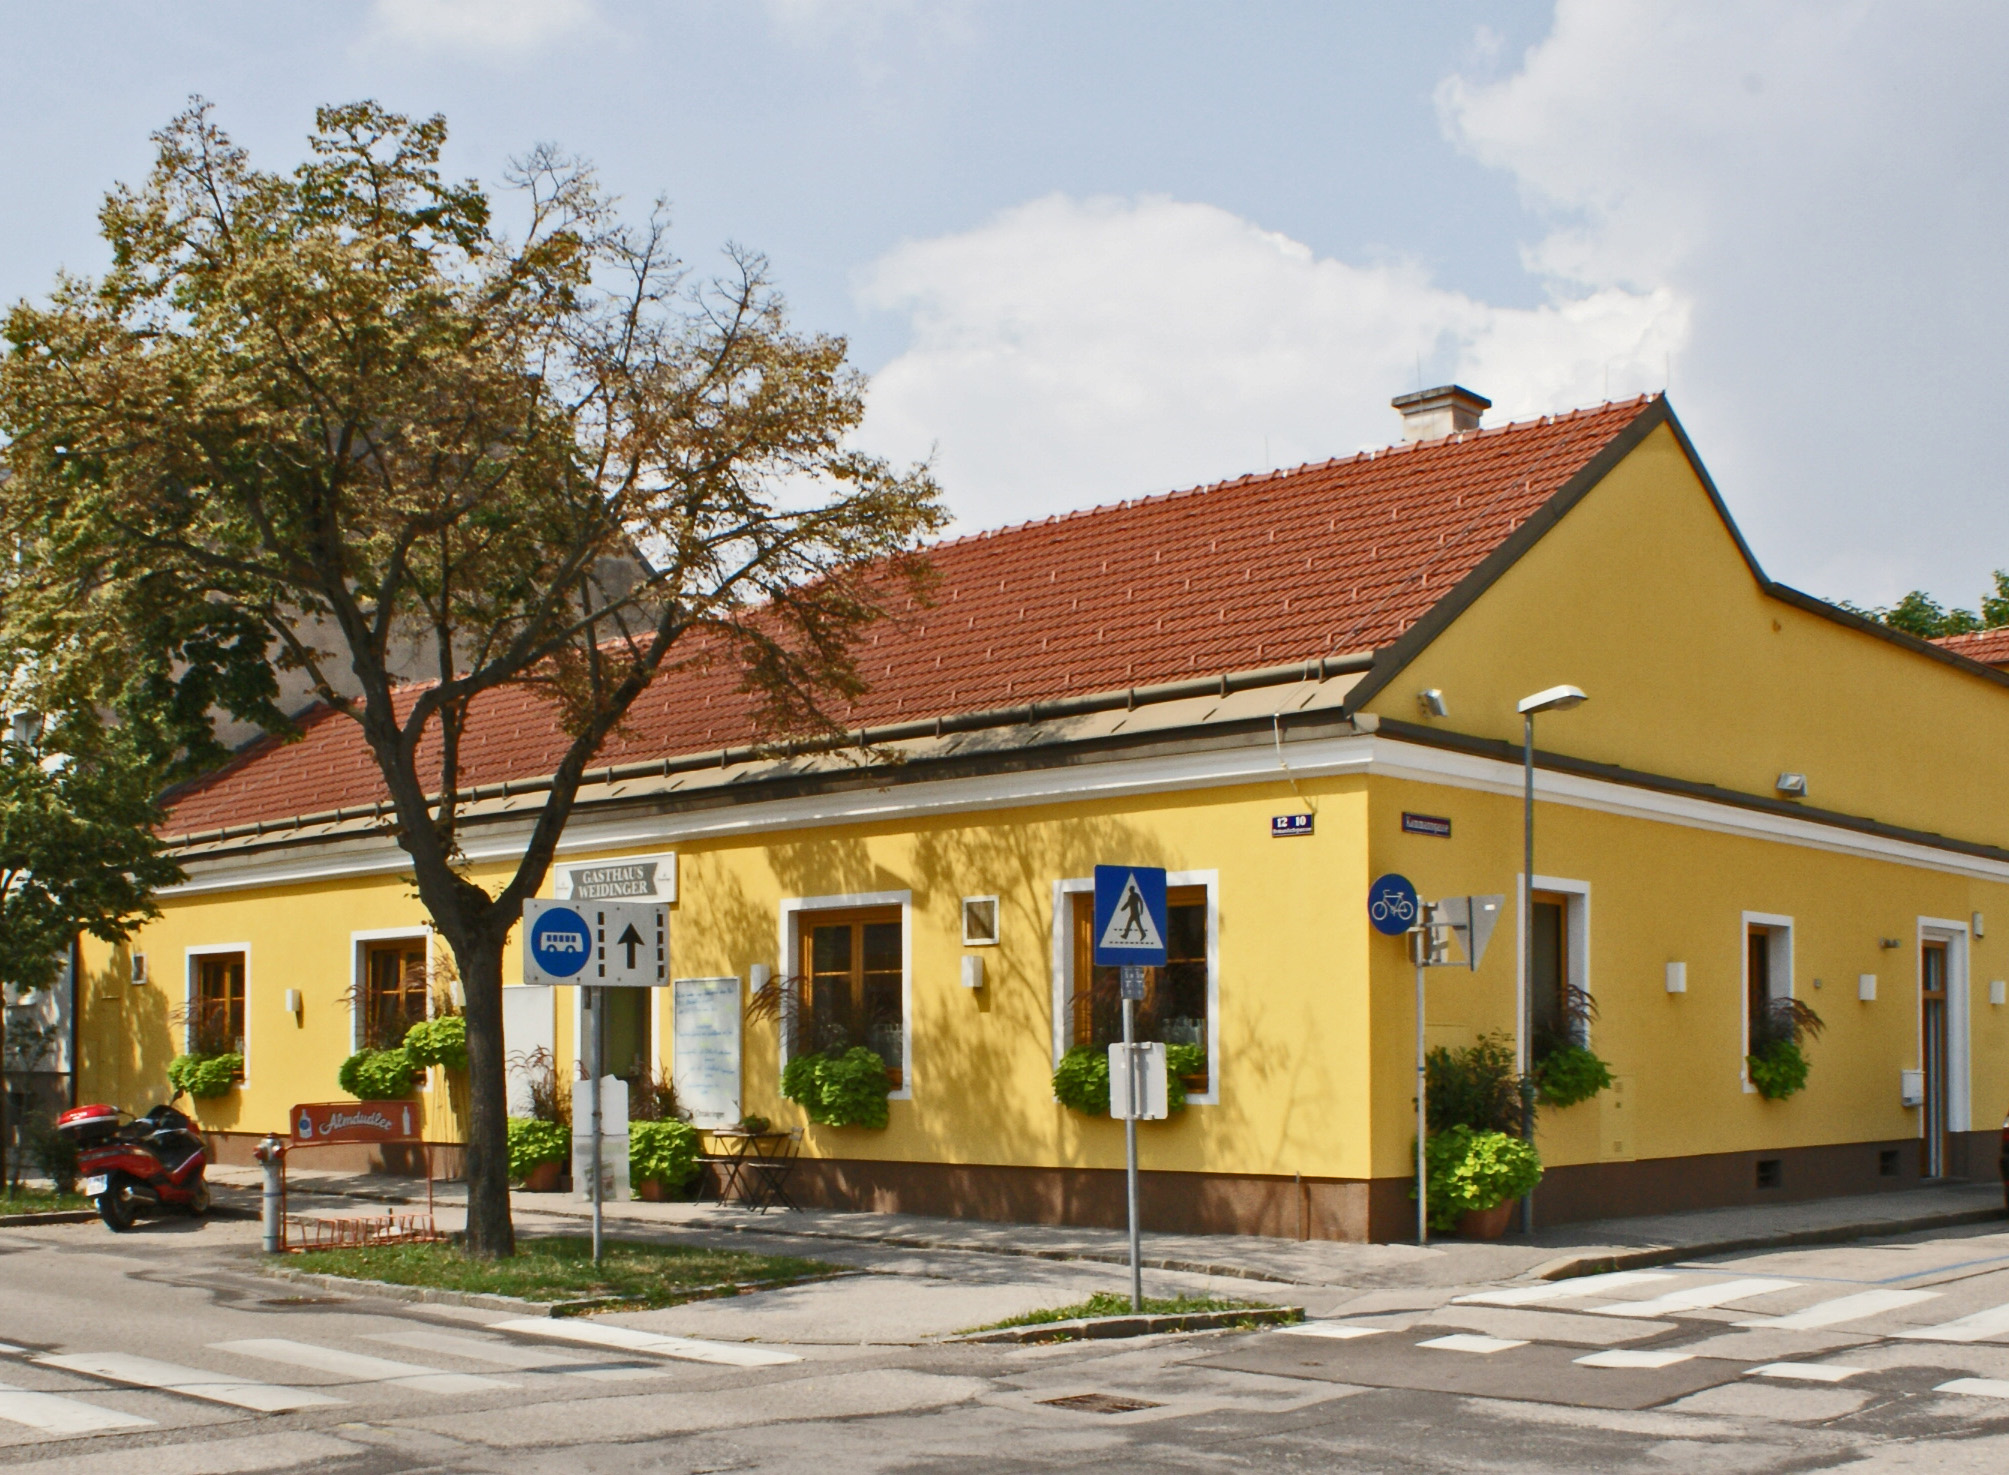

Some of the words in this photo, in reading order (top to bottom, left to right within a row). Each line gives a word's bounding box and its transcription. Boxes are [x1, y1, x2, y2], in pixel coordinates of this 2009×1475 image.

[1277, 817, 1288, 828] 12
[1295, 815, 1307, 826] 10
[582, 865, 644, 884] GASTHAUS
[578, 881, 648, 898] WEIDINGER
[319, 1111, 393, 1135] Almdudler
